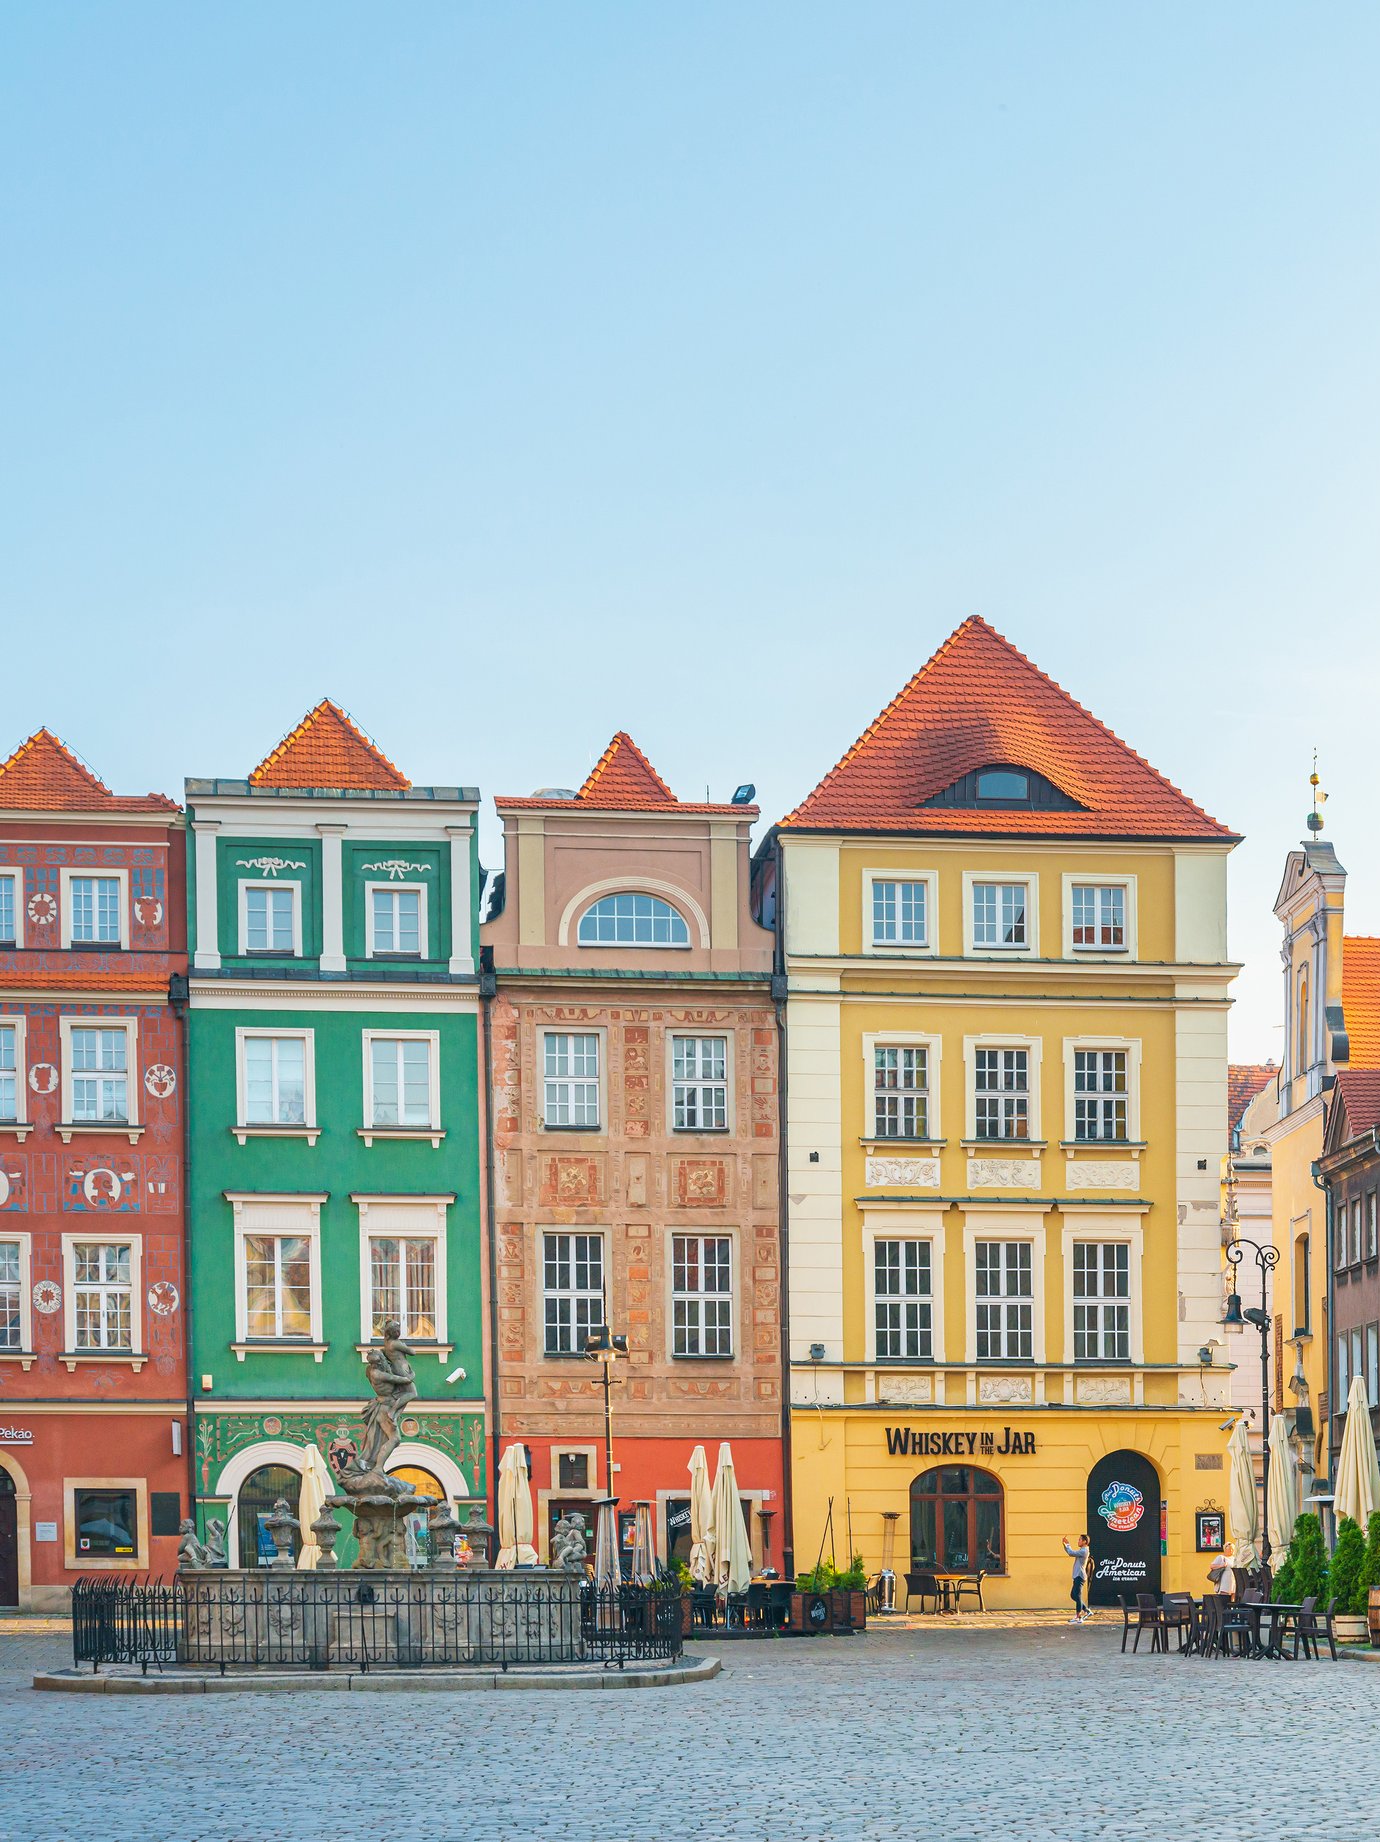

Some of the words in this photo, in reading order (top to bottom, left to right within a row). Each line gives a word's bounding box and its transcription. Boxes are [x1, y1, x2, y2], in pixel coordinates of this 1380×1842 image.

[885, 1427, 977, 1455] WHISKEY
[980, 1432, 994, 1445] IN
[997, 1427, 1036, 1455] JAR
[980, 1445, 994, 1455] THE
[1111, 1557, 1146, 1571] Donuts
[1095, 1565, 1146, 1579] American
